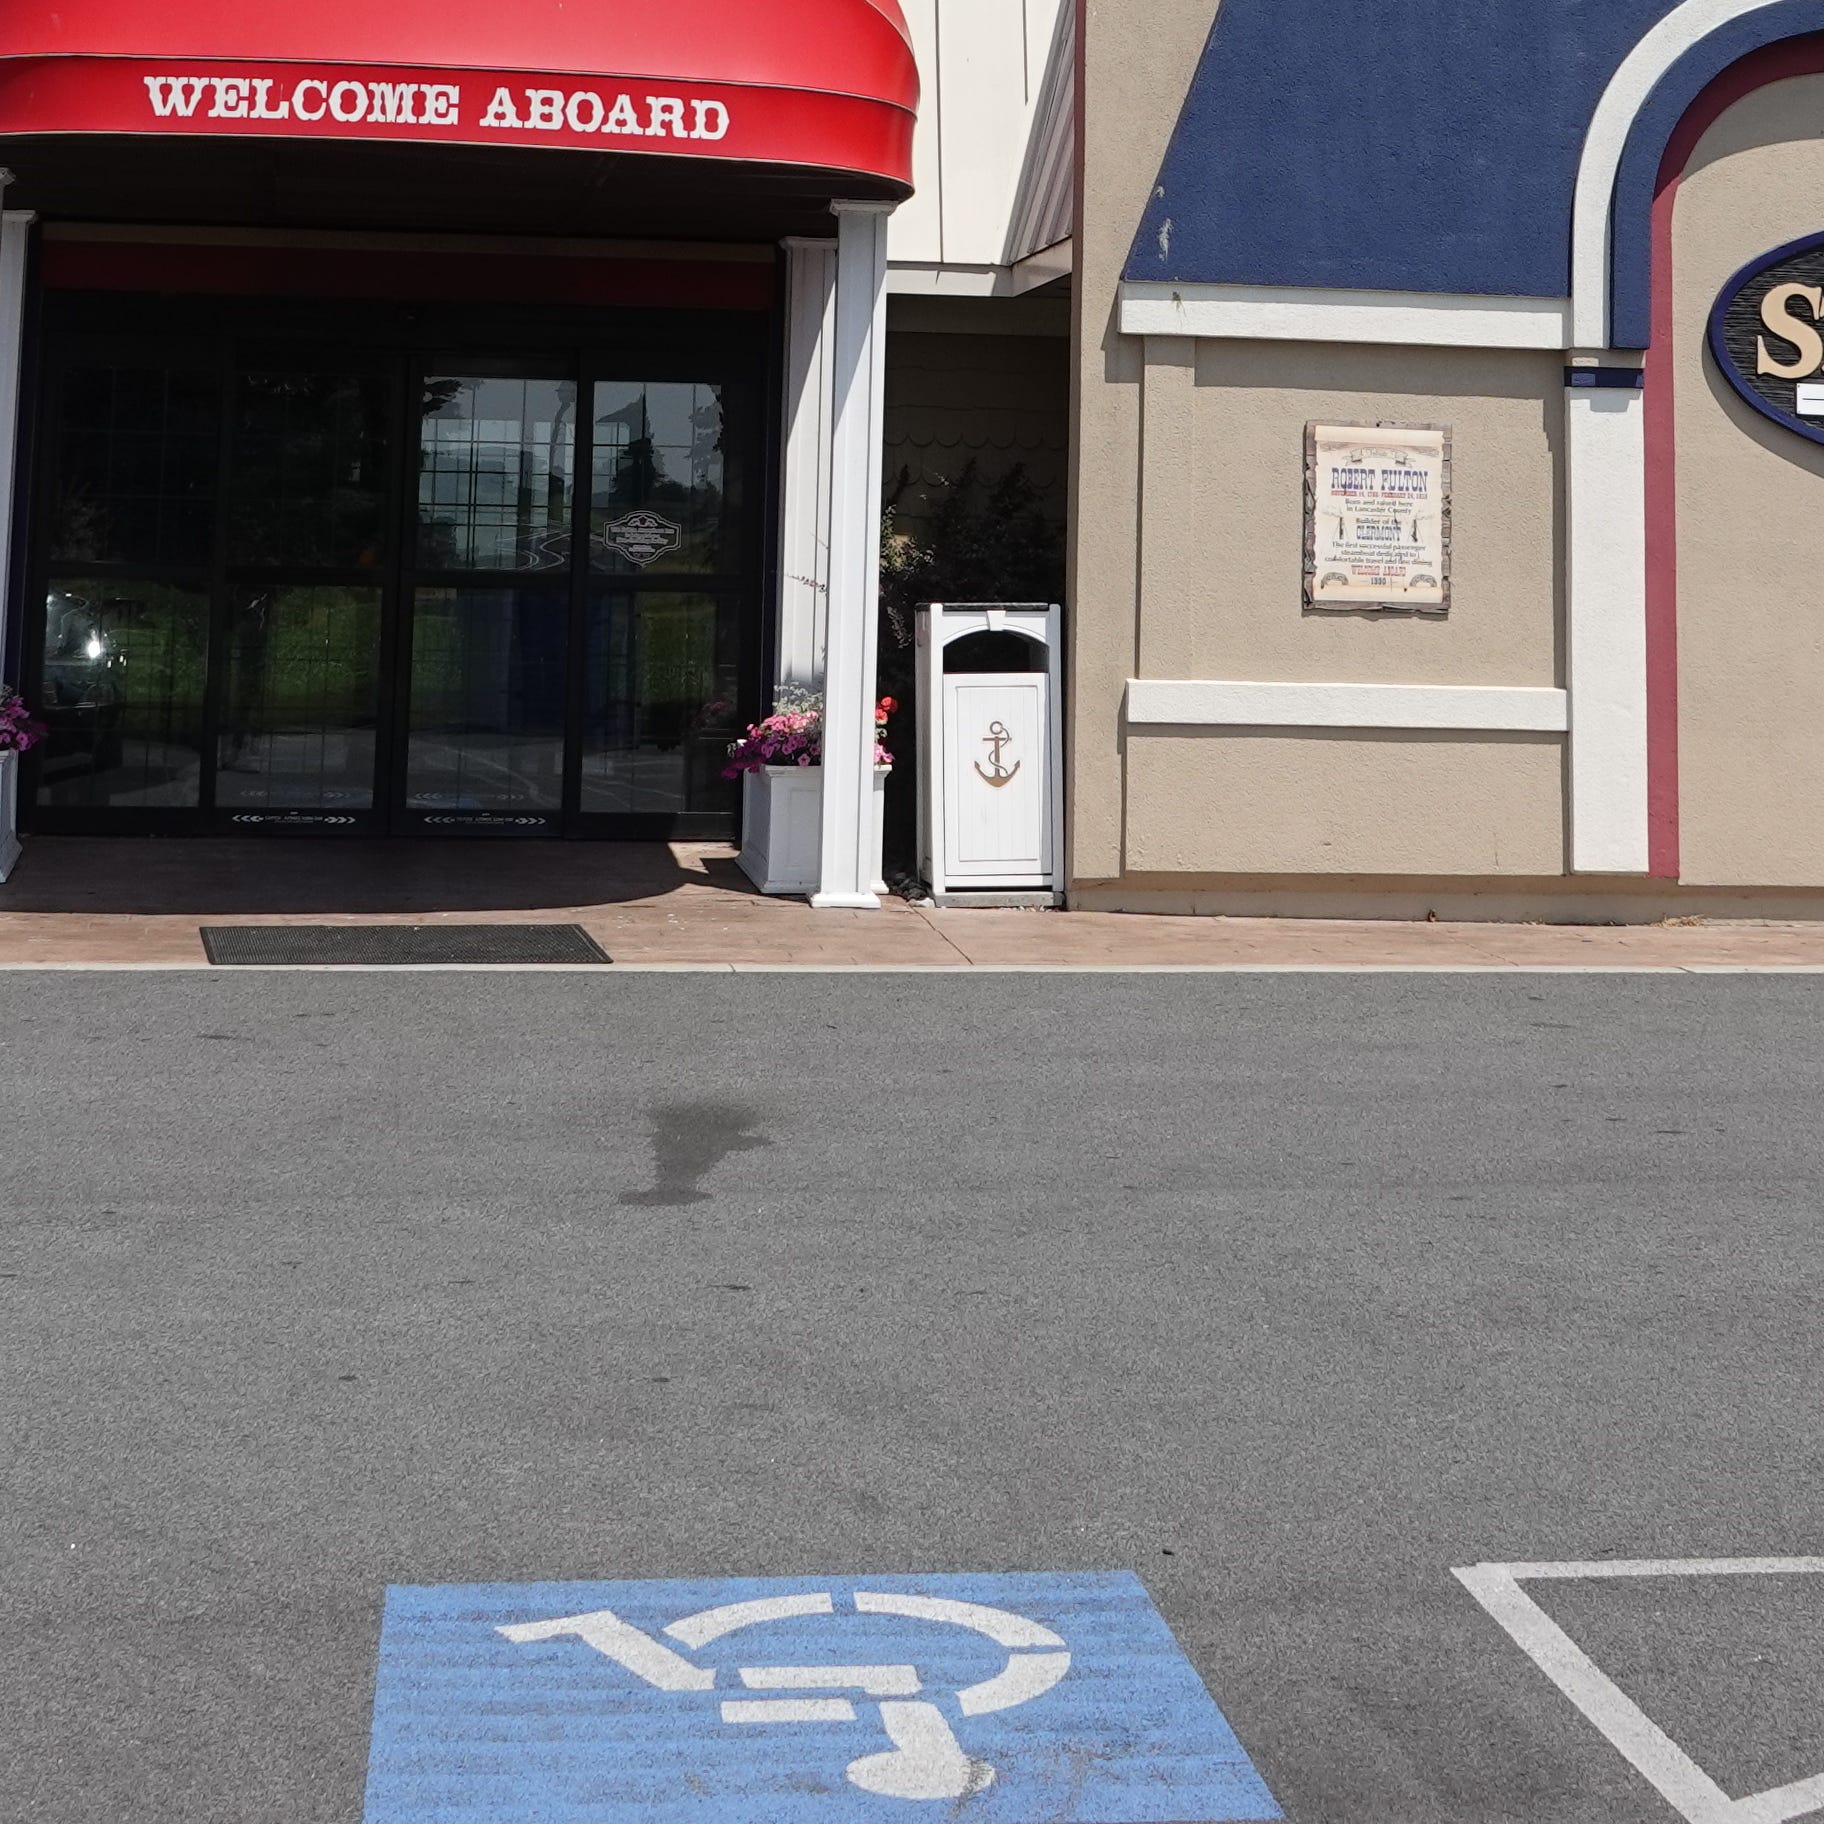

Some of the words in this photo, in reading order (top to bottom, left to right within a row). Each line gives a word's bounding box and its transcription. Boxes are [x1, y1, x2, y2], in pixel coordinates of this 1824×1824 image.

[143, 76, 460, 126] WELCOME
[479, 86, 730, 141] ABOARD
[1331, 467, 1376, 490] ROBERT
[1381, 469, 1428, 492] FULTON
